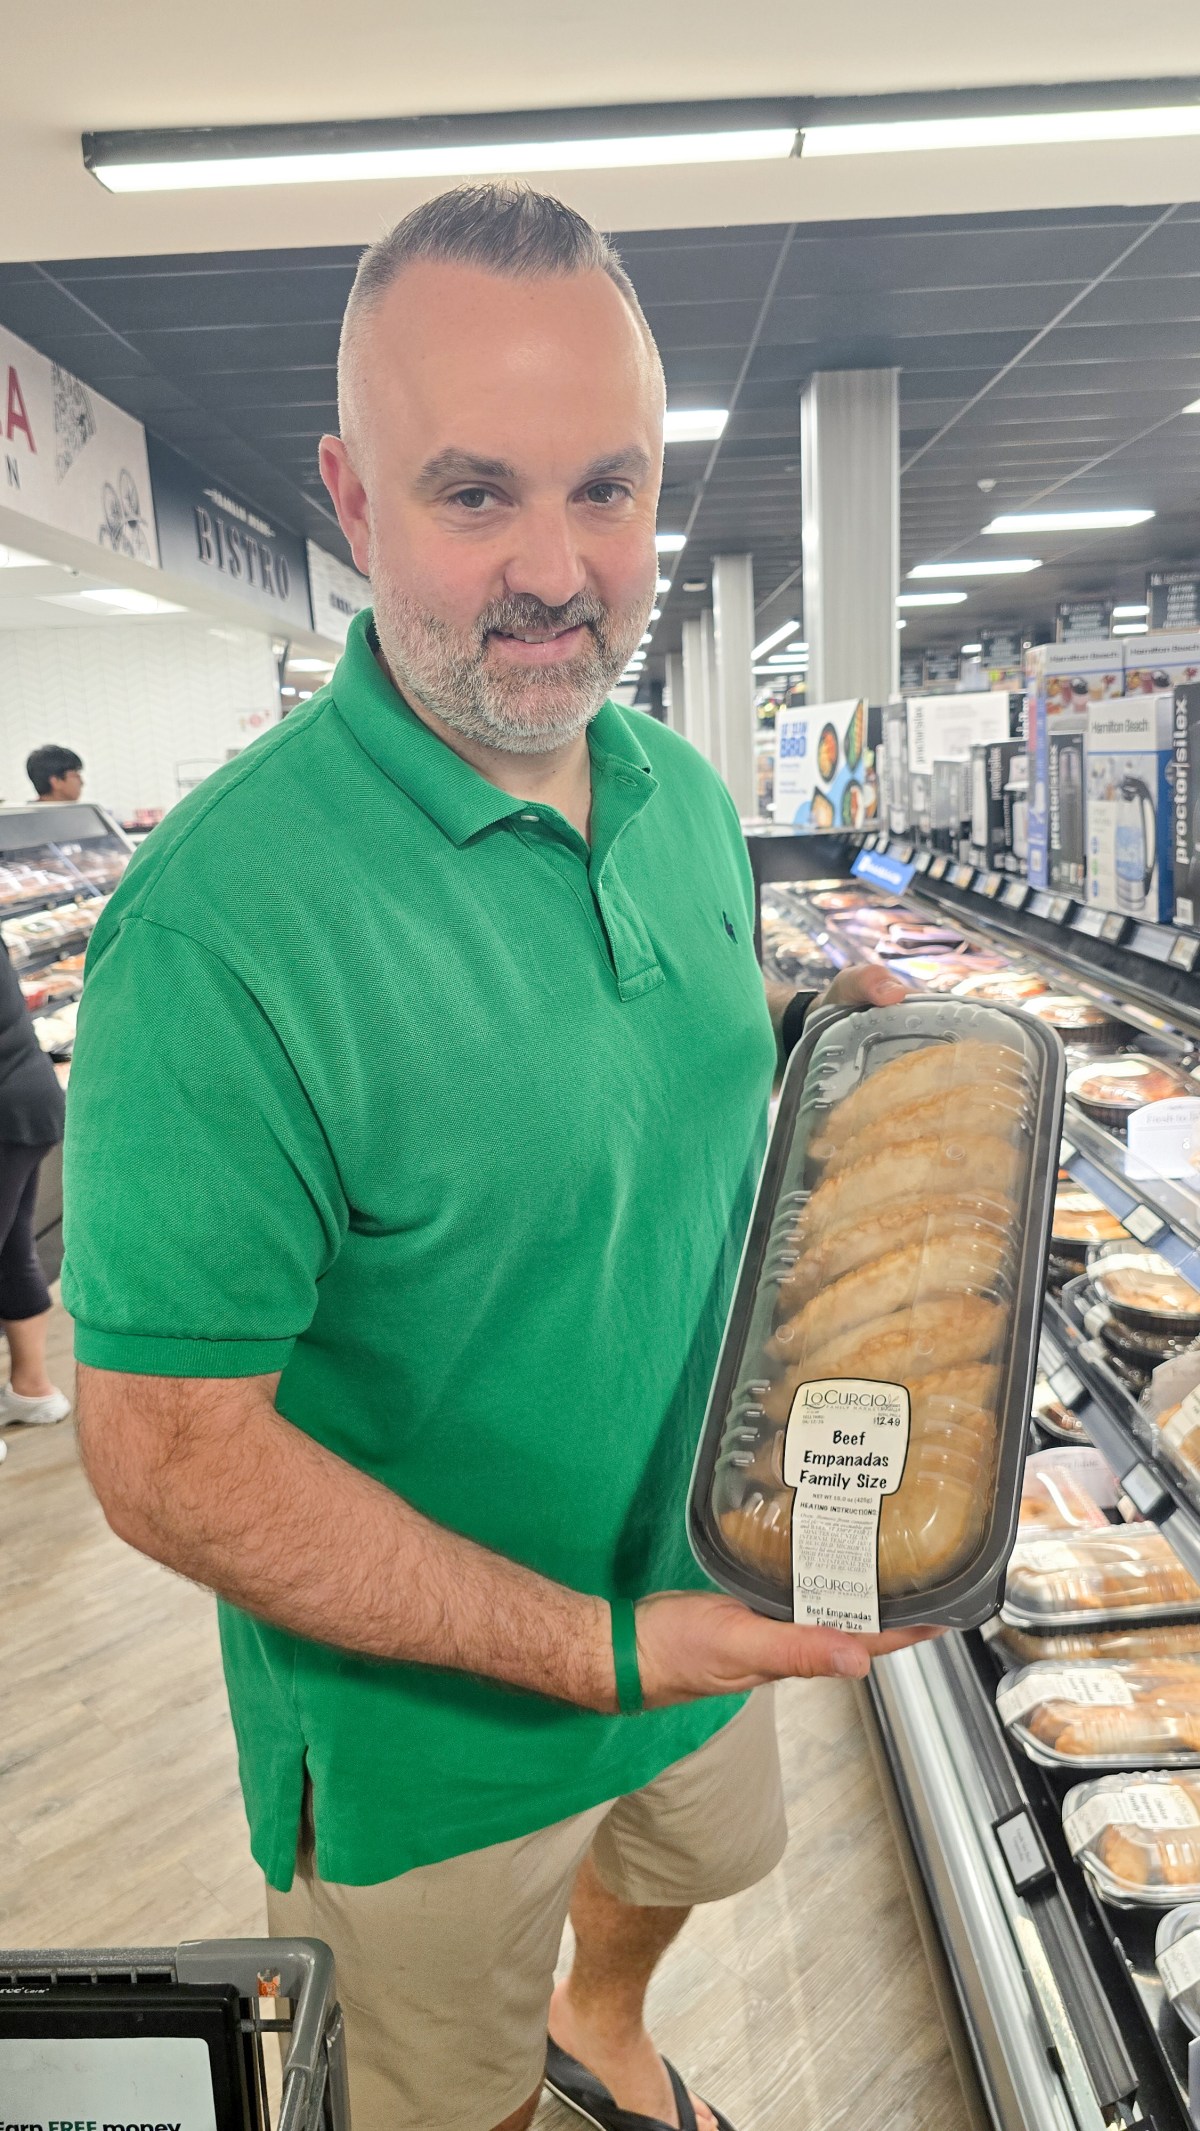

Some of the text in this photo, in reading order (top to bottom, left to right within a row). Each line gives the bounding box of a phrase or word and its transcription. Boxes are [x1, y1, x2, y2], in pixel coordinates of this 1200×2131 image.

[0, 365, 37, 455] A
[195, 506, 291, 602] BISTRO
[1092, 718, 1148, 734] Hamilton Beach
[832, 1430, 866, 1446] Beef
[803, 1450, 889, 1468] Empanadas
[799, 1469, 887, 1490] Family Size
[800, 1502, 828, 1511] HEATING
[806, 1605, 872, 1621] Beef Empanadas
[816, 1617, 863, 1631] Family Size
[48, 2121, 97, 2131] FREE
[103, 2123, 181, 2131] money
